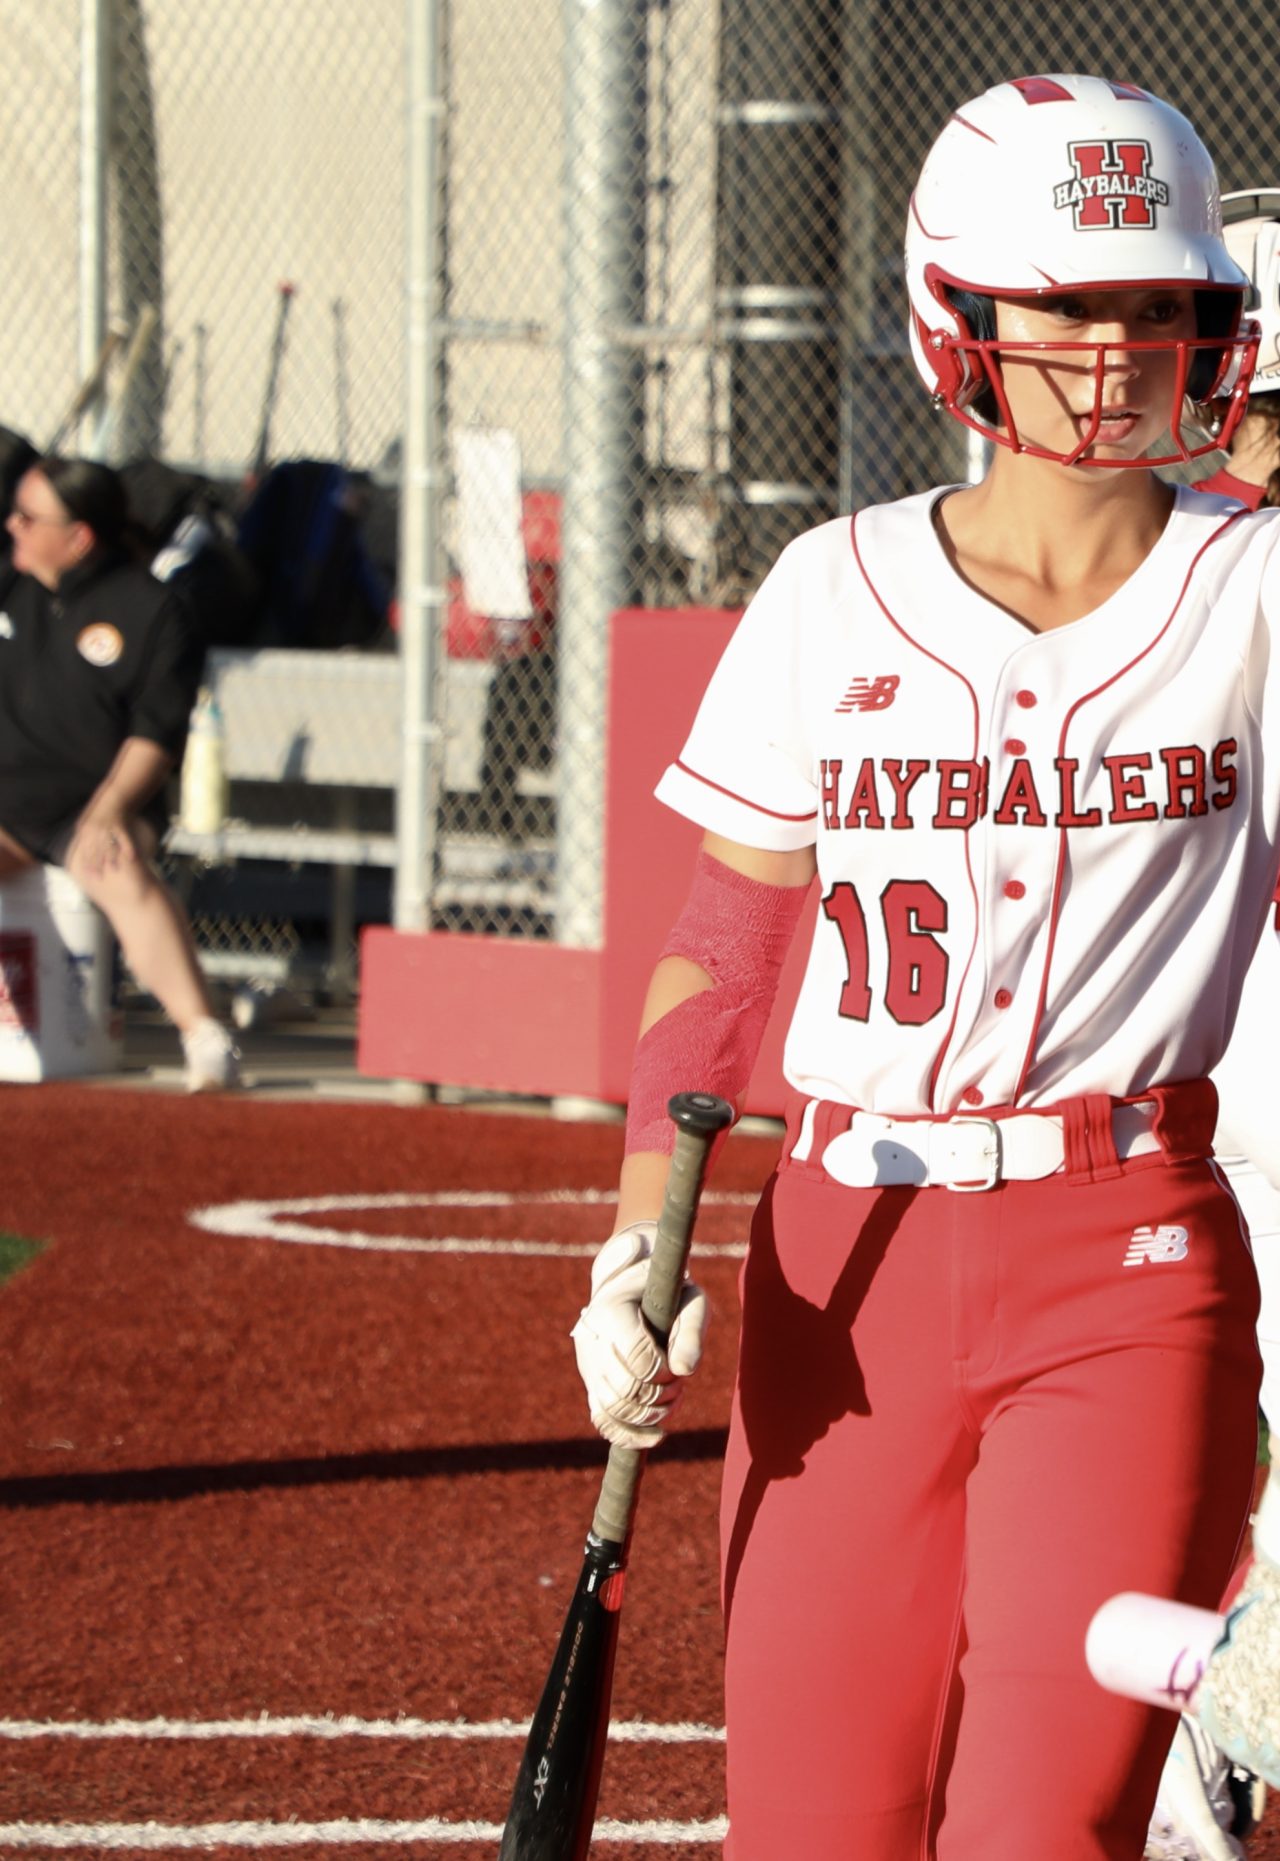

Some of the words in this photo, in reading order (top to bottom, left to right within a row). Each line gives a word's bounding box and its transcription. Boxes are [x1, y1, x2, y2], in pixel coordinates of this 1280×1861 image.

[1054, 174, 1168, 209] HAYBALERS
[820, 737, 1238, 831] HAYBALERS
[820, 878, 950, 1027] 16
